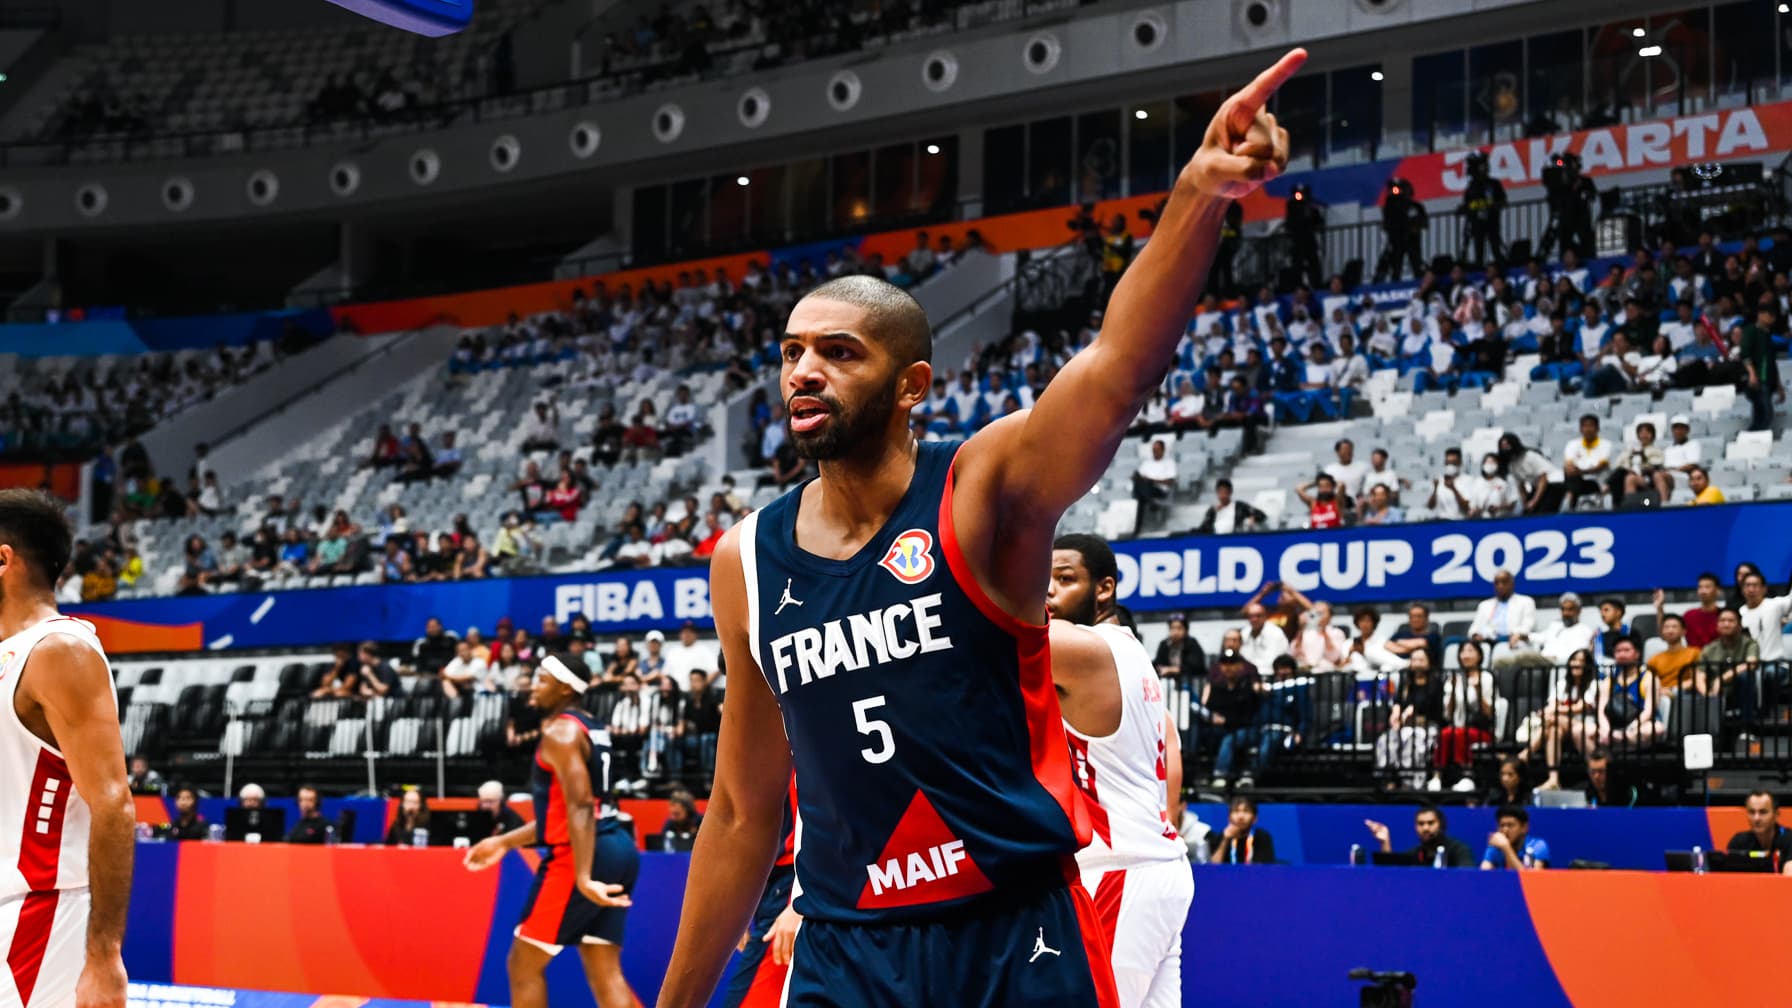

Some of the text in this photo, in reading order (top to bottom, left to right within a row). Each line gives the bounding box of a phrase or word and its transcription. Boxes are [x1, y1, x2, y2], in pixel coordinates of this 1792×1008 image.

[1442, 109, 1768, 191] JAKARTA
[555, 580, 664, 625] FIBA
[1114, 546, 1264, 600] ORLD
[1279, 539, 1414, 591] CUP
[1431, 526, 1615, 584] 2023
[769, 592, 953, 694] FRANCE
[852, 695, 895, 764] 5
[866, 839, 967, 896] MAIF
